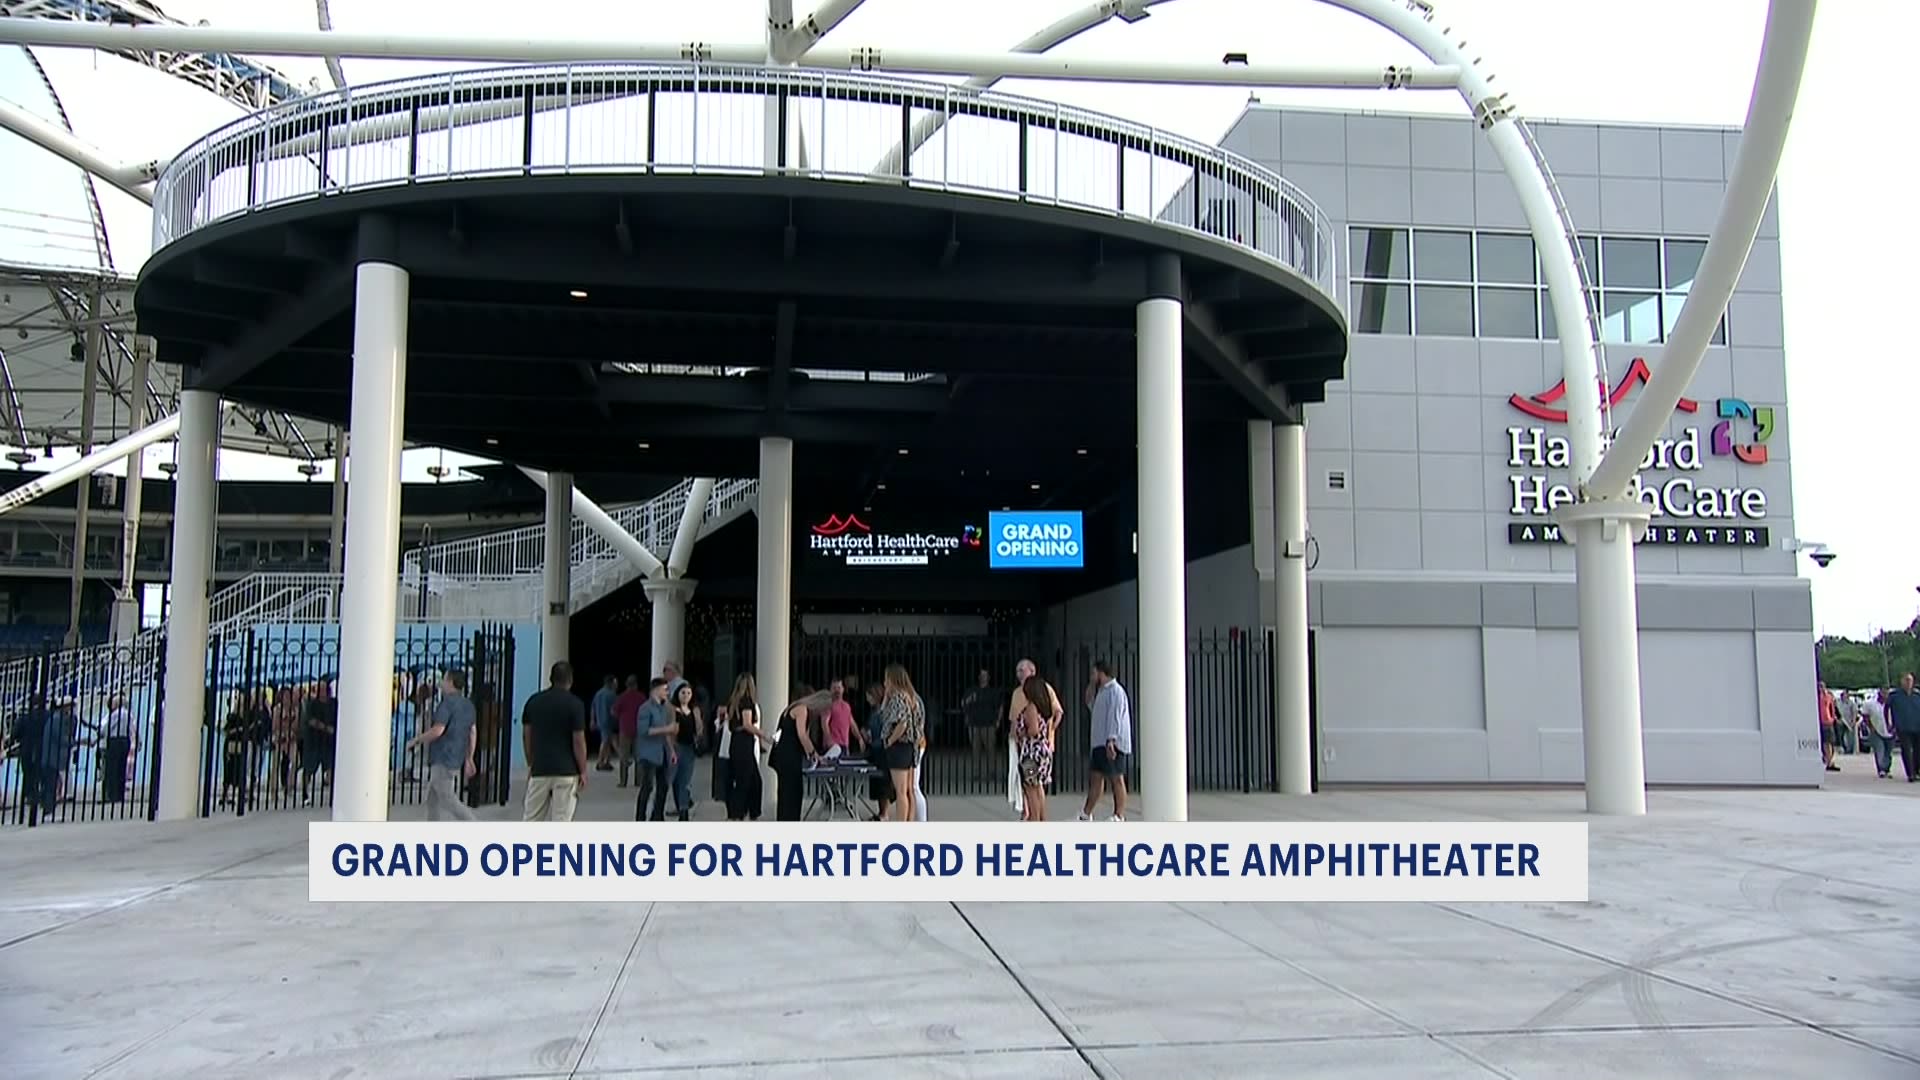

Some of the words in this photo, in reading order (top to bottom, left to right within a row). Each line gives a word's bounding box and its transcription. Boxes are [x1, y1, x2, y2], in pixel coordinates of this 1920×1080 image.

[1509, 475, 1766, 518] HehCare
[1002, 523, 1073, 540] GRAND
[1521, 526, 1757, 543] AMHEATER
[810, 533, 872, 548] Hartford
[877, 533, 959, 548] HealthCare
[996, 540, 1079, 557] OPENING
